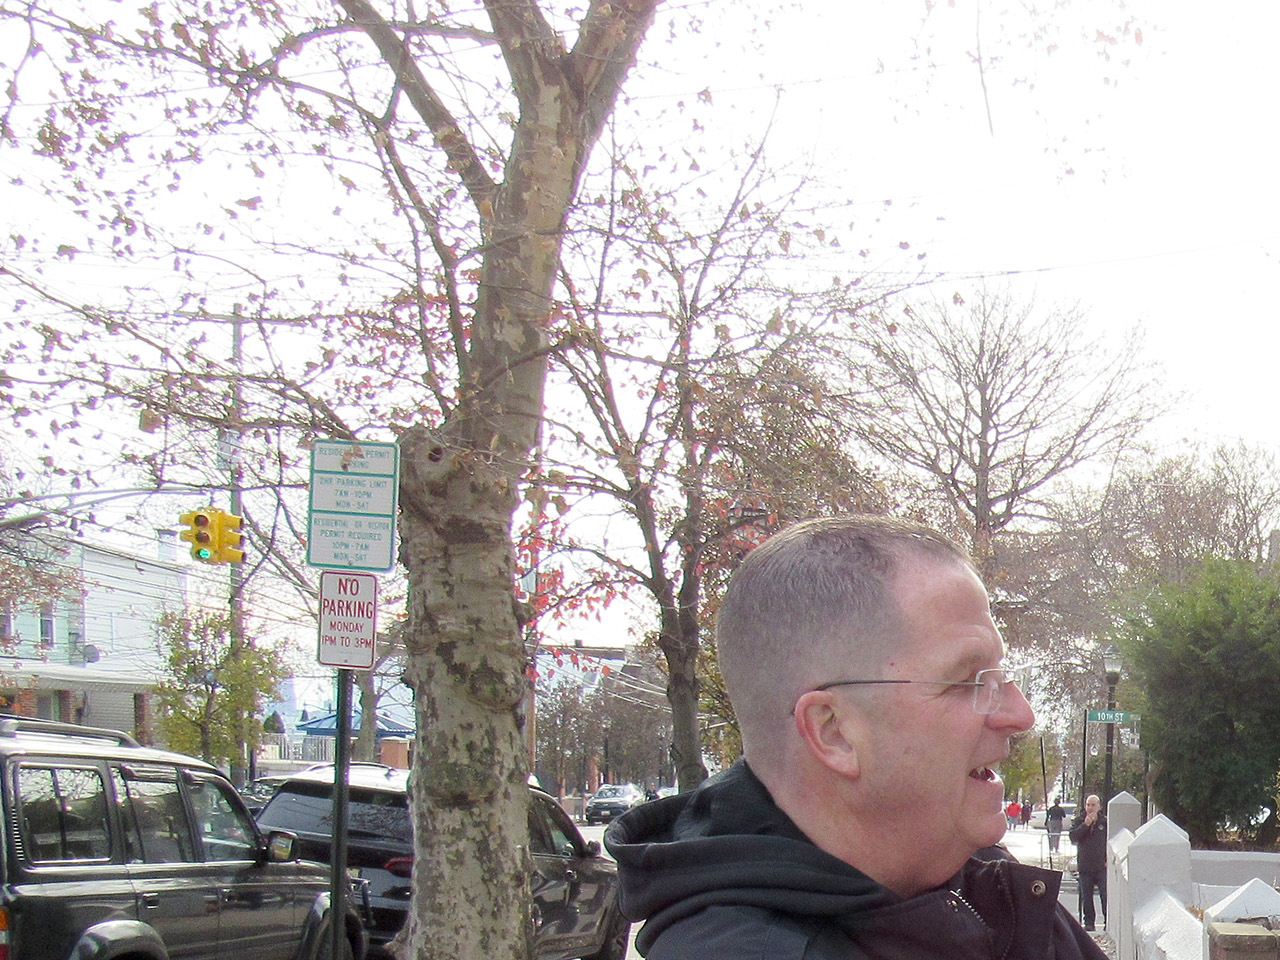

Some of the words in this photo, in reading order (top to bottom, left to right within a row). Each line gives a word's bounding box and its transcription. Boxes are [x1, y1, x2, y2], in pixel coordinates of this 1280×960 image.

[365, 450, 391, 459] PERMIT
[319, 477, 333, 485] 2HR
[336, 478, 367, 488] PARKING
[369, 480, 388, 489] LIMIT
[335, 500, 351, 509] MON
[357, 501, 369, 510] SAT
[314, 518, 349, 528] RESIDENTIAL
[368, 522, 390, 530] VISITOR
[320, 529, 345, 538] PERMIT
[348, 531, 382, 541] REQUIRED
[333, 552, 349, 561] MON
[355, 553, 367, 562] SAT
[338, 578, 359, 596] NO
[322, 599, 373, 619] PARKING
[330, 621, 364, 633] MONDAY
[321, 635, 337, 646] 1PM
[340, 636, 351, 648] TO
[354, 637, 372, 649] 3PM
[1097, 712, 1113, 721] 10TH
[1114, 712, 1124, 721] ST
